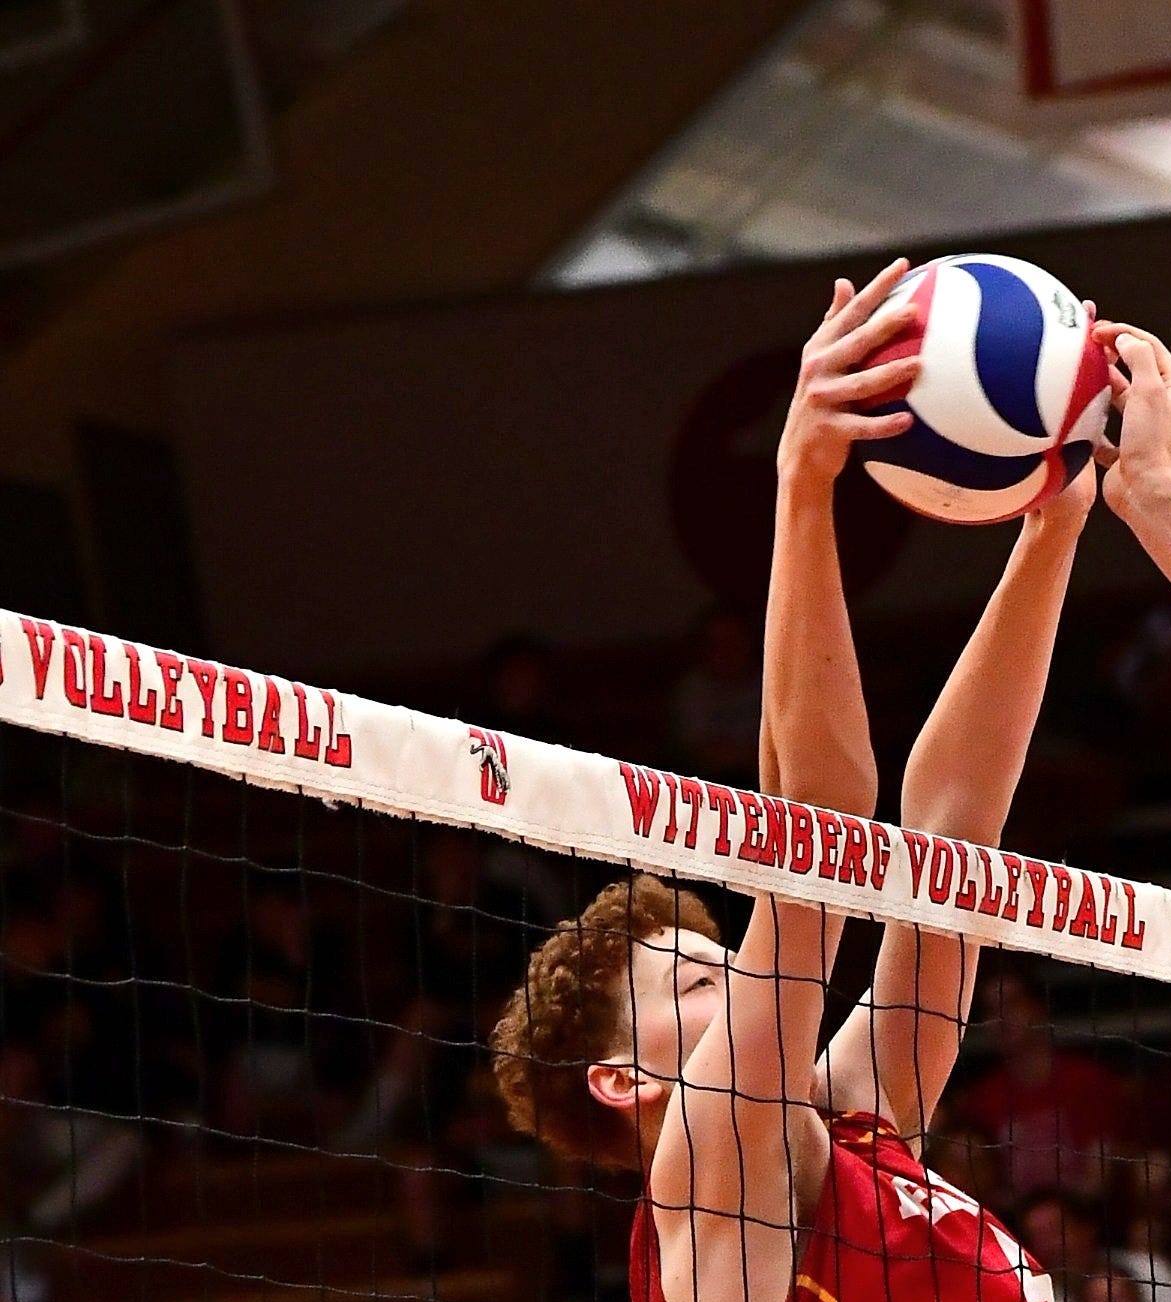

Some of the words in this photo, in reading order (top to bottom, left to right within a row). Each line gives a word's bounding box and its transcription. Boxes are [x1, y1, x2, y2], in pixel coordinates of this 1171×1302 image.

[19, 617, 352, 768] VOLLEYBALL
[619, 762, 891, 891] WITTENBERG
[901, 830, 1146, 951] VOLLEYBALL
